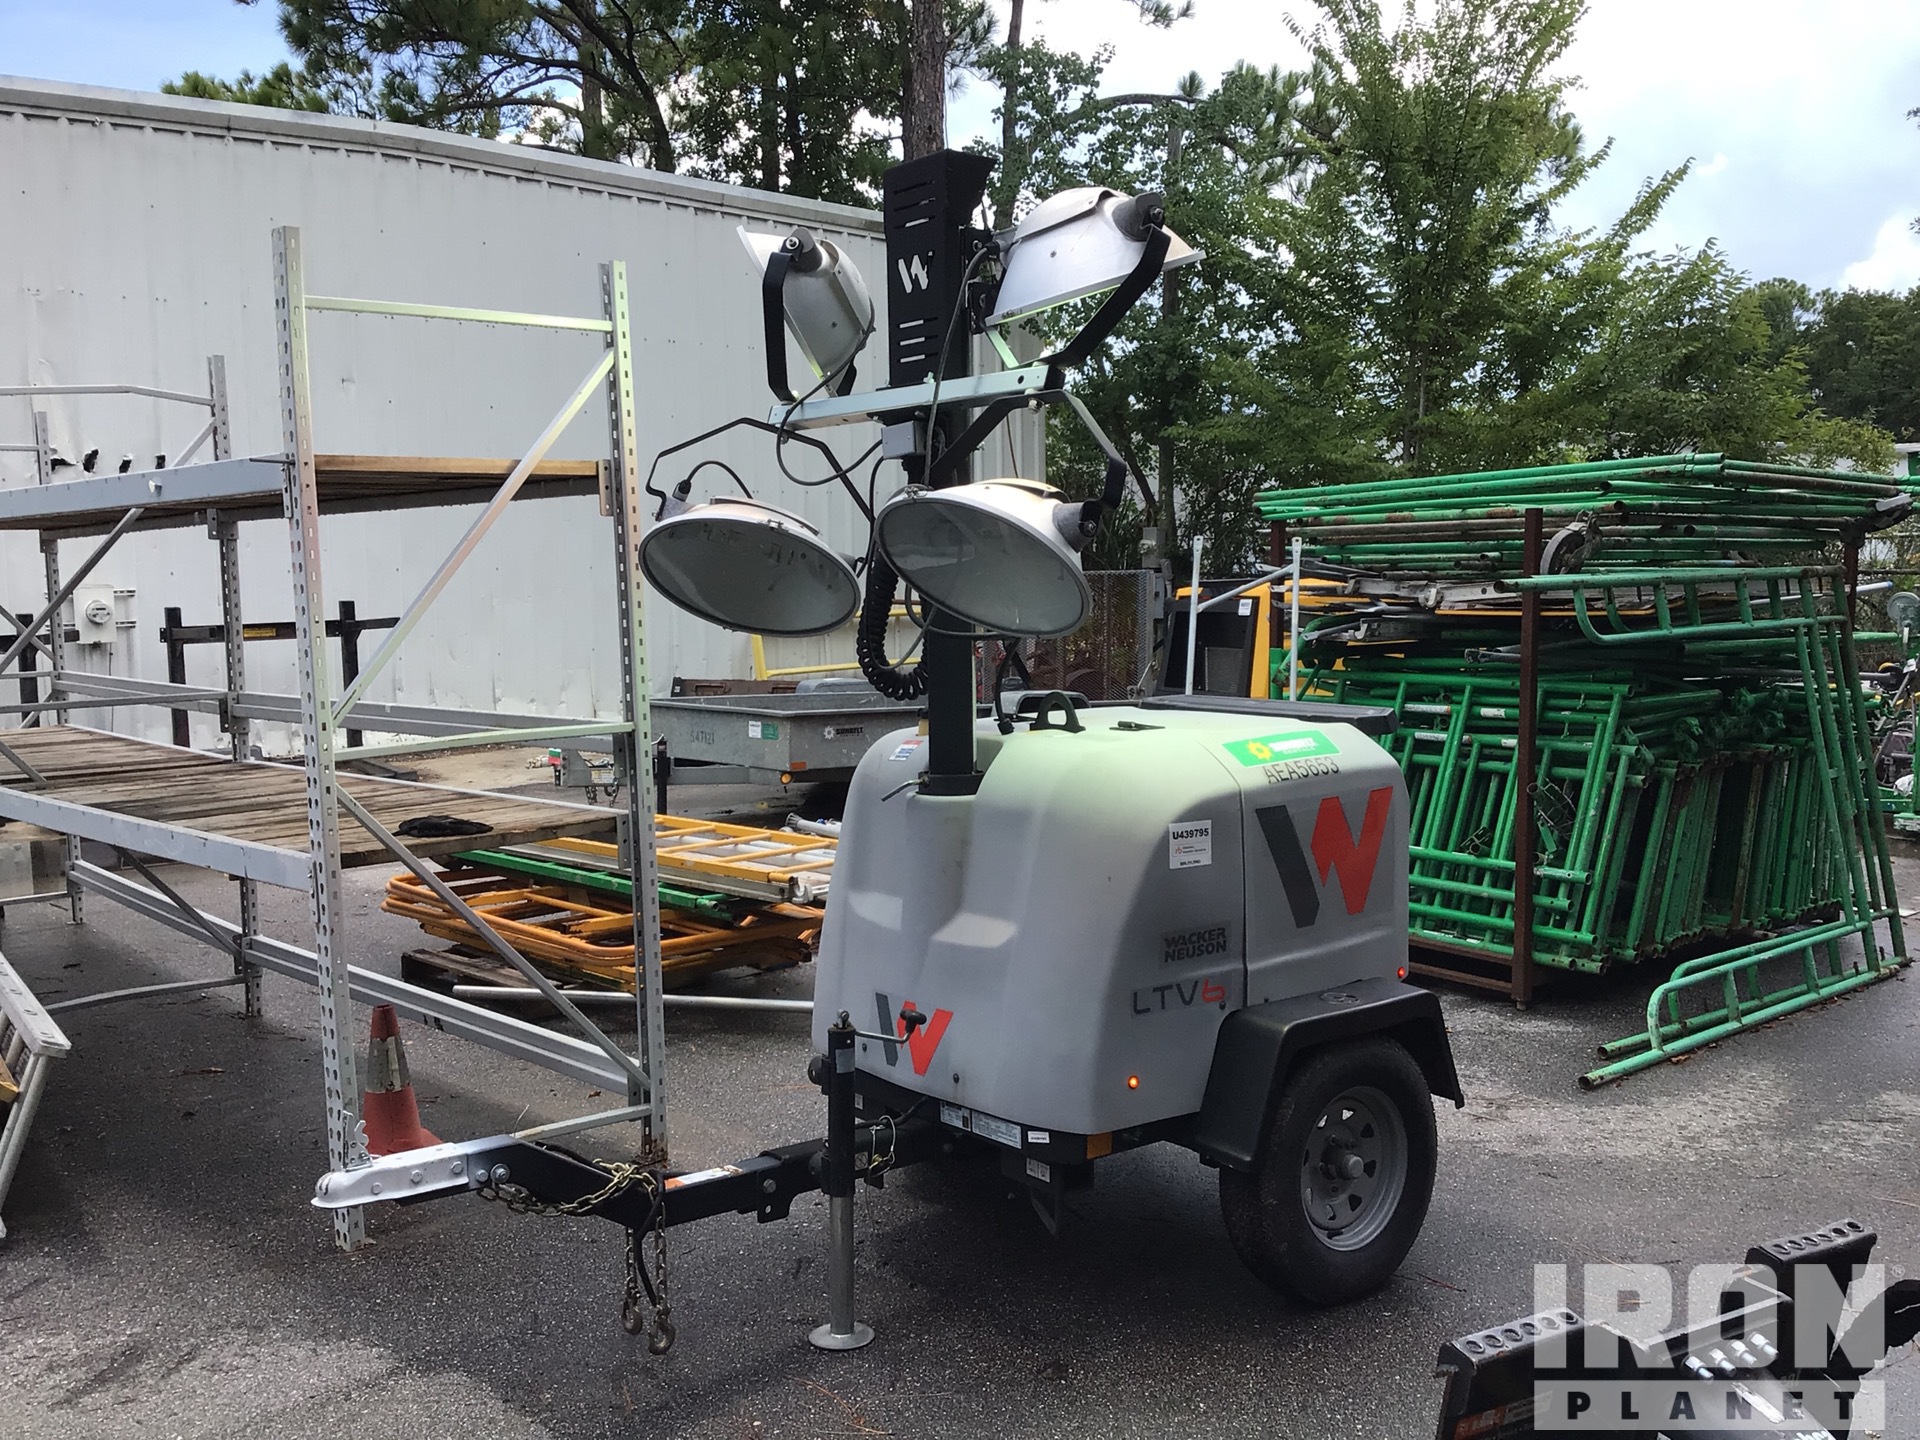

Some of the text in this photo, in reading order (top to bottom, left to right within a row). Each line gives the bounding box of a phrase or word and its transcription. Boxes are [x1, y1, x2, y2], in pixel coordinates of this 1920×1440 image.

[1262, 757, 1340, 784] AEA5653
[1172, 827, 1210, 840] U439795
[1164, 927, 1227, 950] WACKER
[1164, 939, 1227, 963] NEUSON
[1133, 977, 1226, 1015] LTV6
